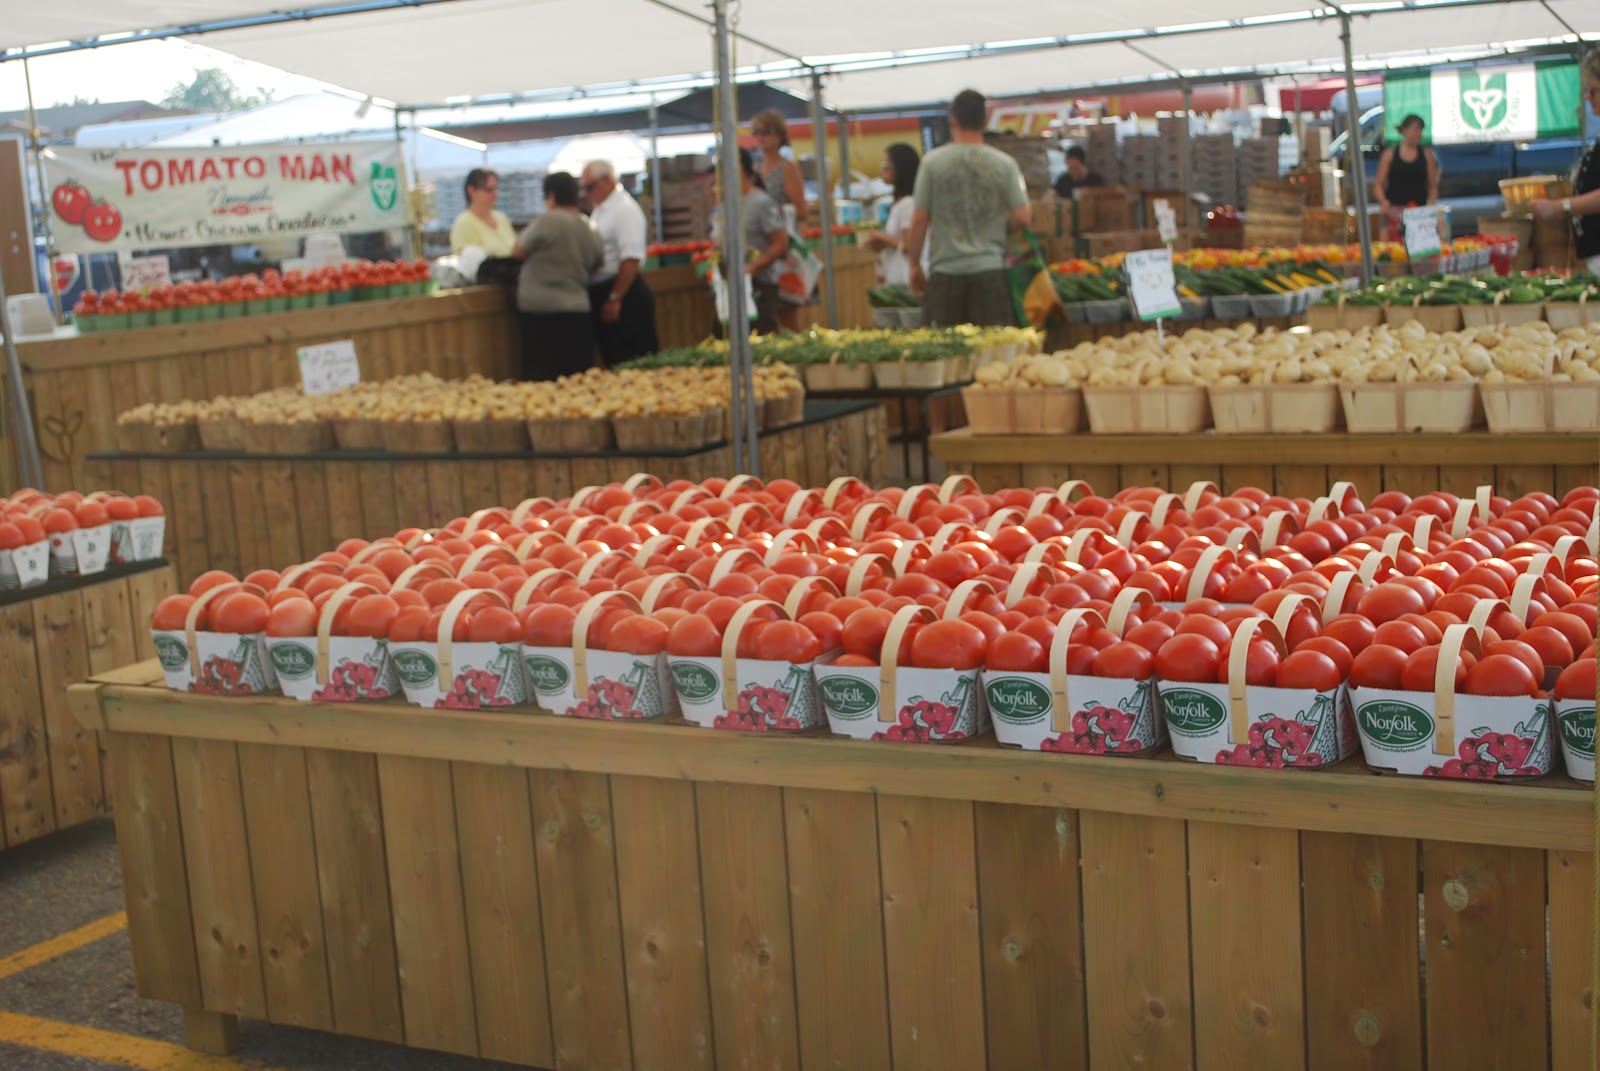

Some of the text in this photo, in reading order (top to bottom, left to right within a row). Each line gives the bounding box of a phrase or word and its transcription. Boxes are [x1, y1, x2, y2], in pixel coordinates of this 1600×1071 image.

[115, 156, 267, 197] TOMATO
[280, 153, 356, 185] MAN
[823, 684, 865, 710] Norfolk
[992, 688, 1038, 714] Norfolk
[1164, 698, 1210, 725] Norfolk
[1366, 711, 1418, 740] Norfolk
